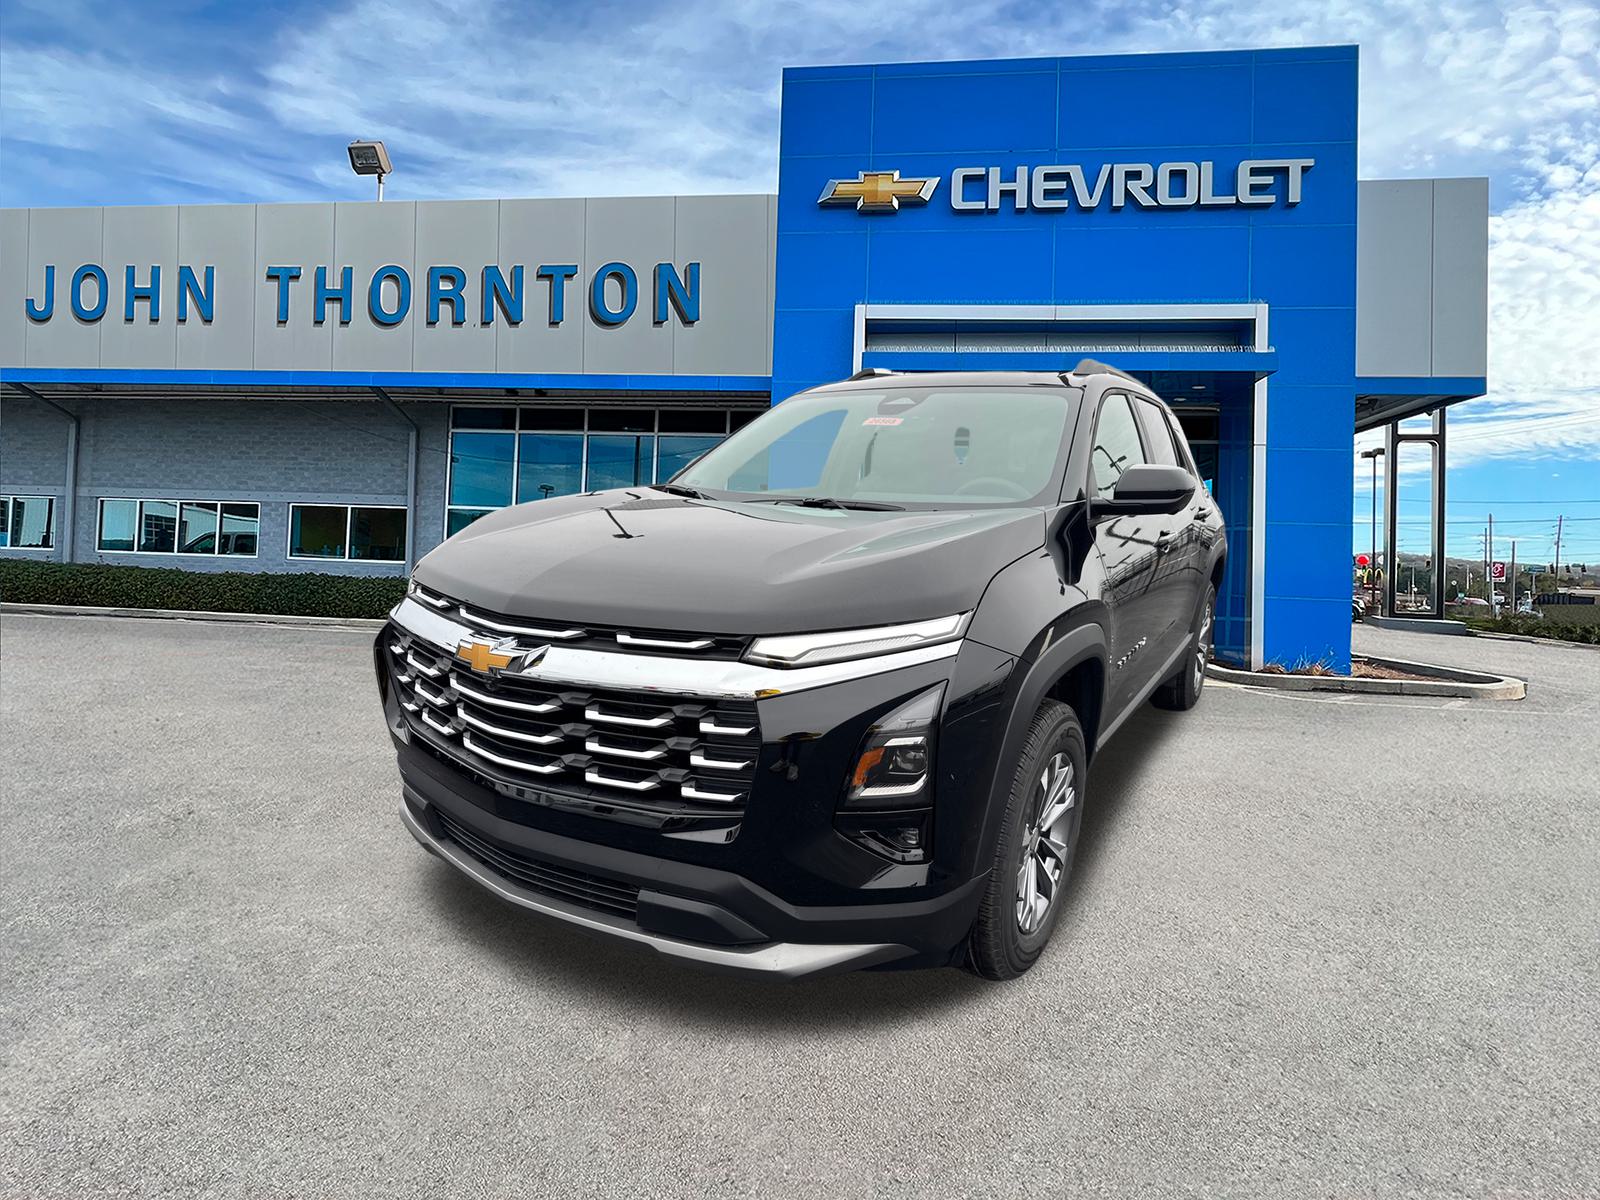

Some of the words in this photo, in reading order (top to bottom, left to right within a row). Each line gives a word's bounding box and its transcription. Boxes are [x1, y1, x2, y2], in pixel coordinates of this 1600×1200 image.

[950, 158, 1316, 211] CHEVROLET
[25, 264, 216, 322] JOHN
[266, 262, 701, 327] THORNTON
